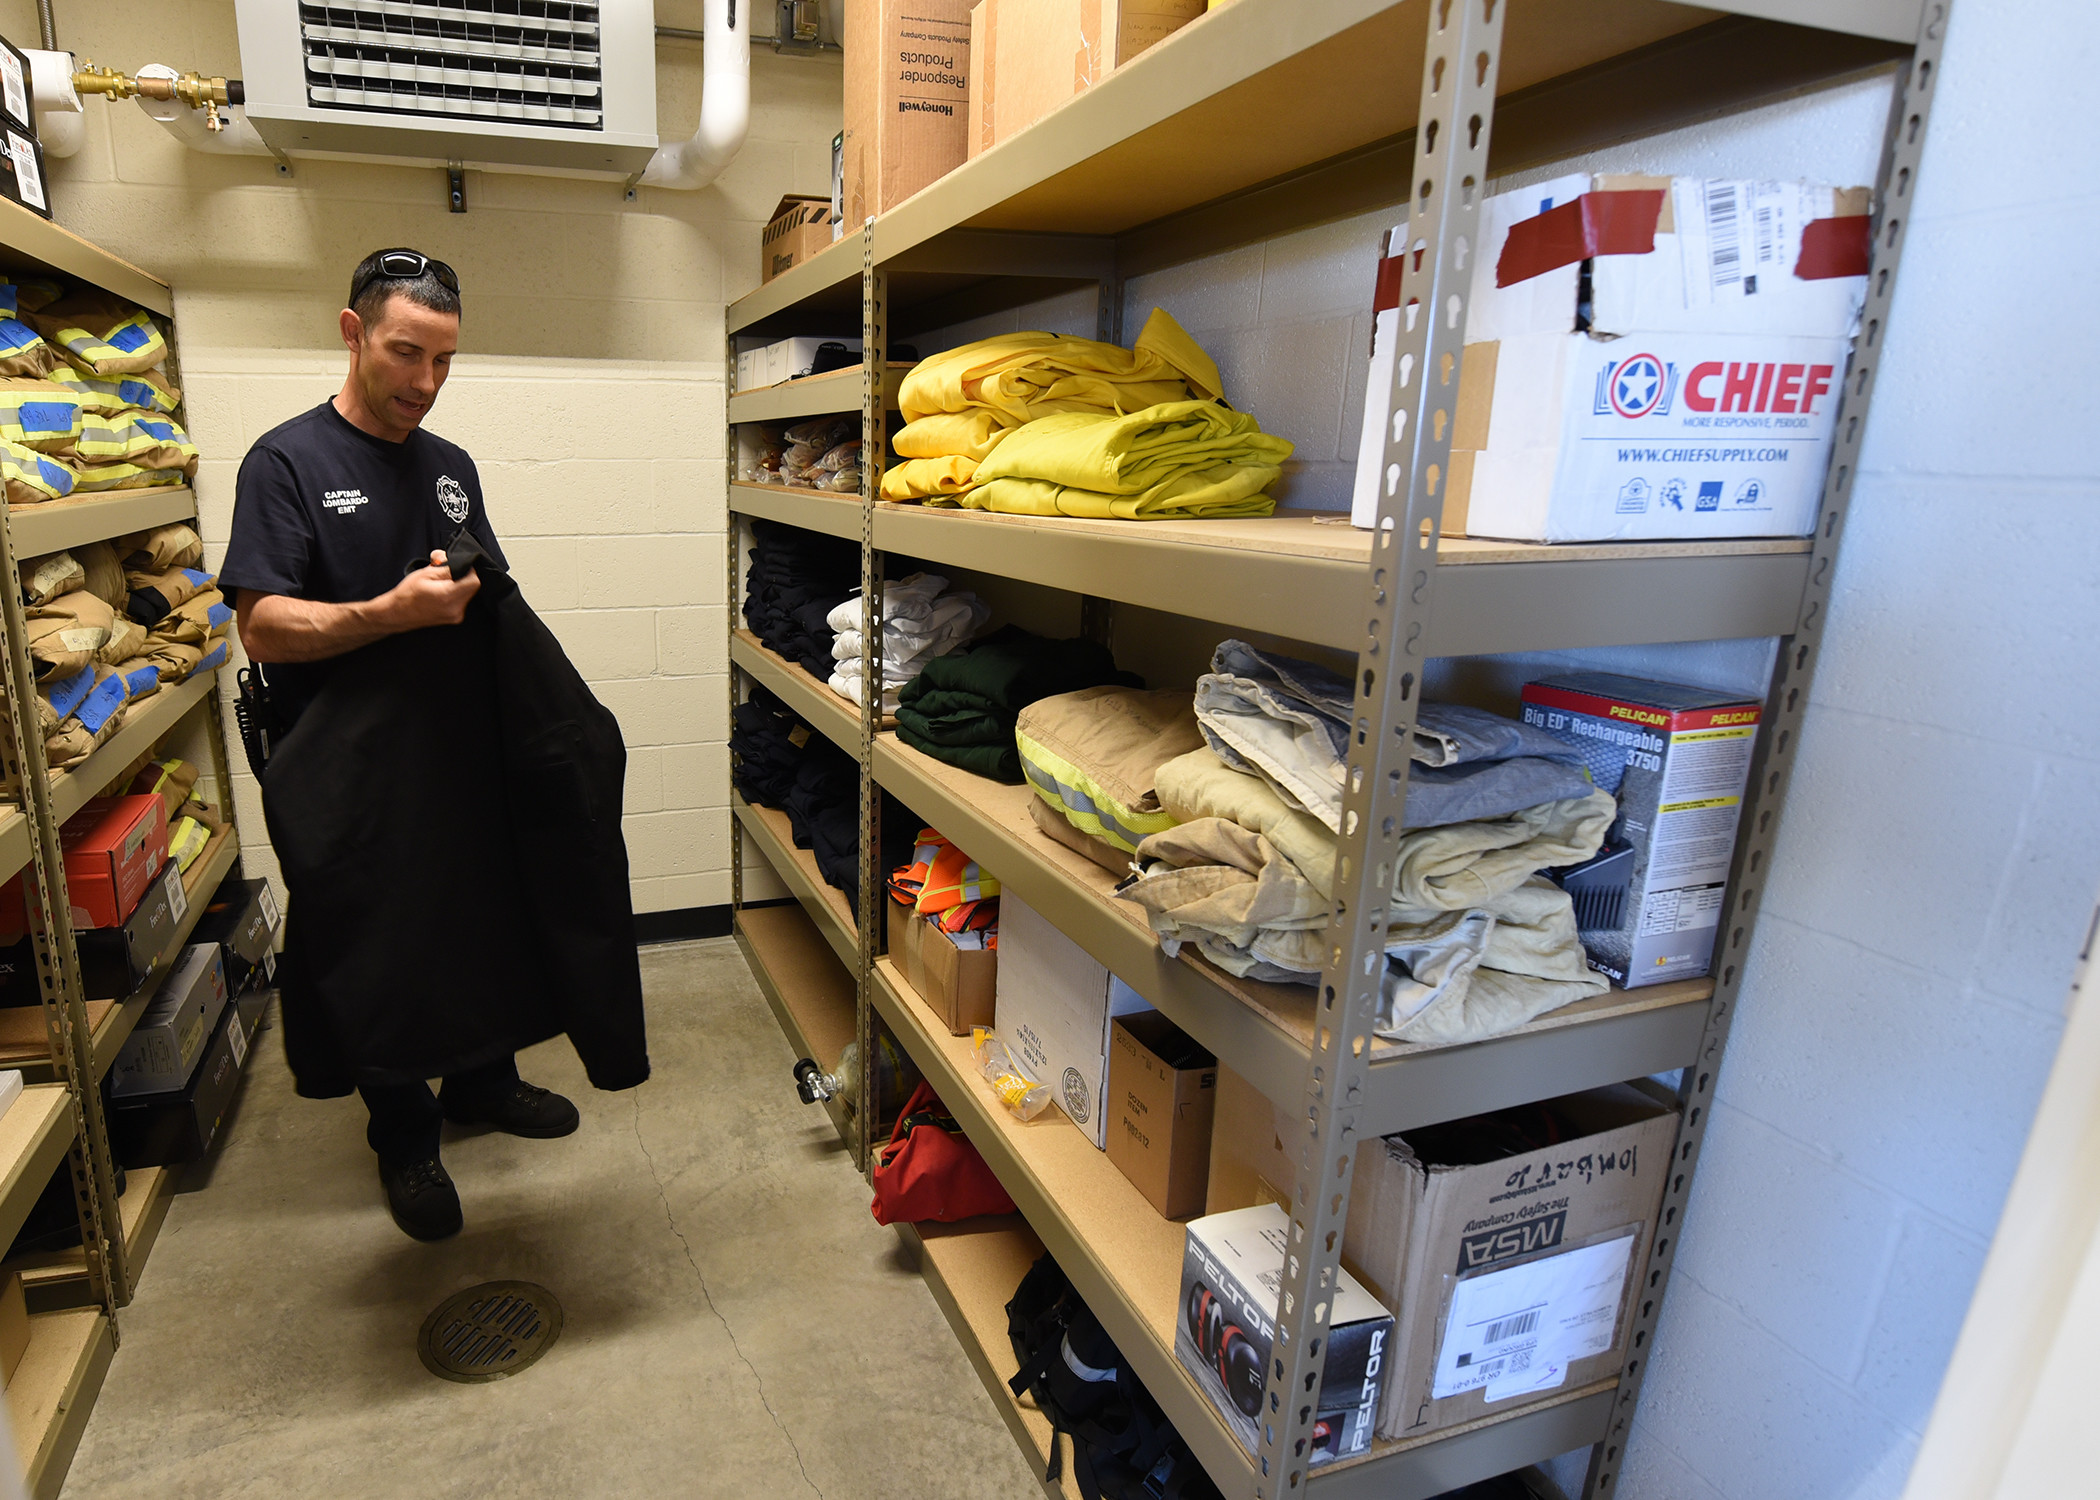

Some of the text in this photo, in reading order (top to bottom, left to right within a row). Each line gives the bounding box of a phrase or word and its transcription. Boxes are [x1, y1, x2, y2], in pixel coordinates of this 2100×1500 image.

[900, 30, 970, 45] Safety Products Company
[900, 52, 953, 69] Products
[899, 71, 965, 88] Responder
[899, 101, 953, 116] Honeywell
[1683, 361, 1834, 413] CHIEF
[1682, 417, 1809, 429] MORE RESPONSIVE, PERIOD.
[1617, 448, 1788, 463] WWW.CHIEFSUPPLY.COM
[322, 496, 369, 507] LOMBARDO
[324, 489, 361, 499] CAPTAIN
[1696, 495, 1718, 509] GSA
[338, 506, 356, 514] EMT
[1609, 705, 1667, 726] PELICAN
[1710, 711, 1756, 726] PELICAN
[1524, 707, 1545, 728] Big
[1571, 717, 1664, 753] Rechargeable
[1625, 749, 1661, 773] 3750
[1127, 1091, 1149, 1114] DOZEN
[1127, 1100, 1141, 1118] ITEM
[1462, 1196, 1570, 1233] The Safety Company
[1465, 1216, 1561, 1266] MSA
[1351, 1328, 1387, 1452] PELTOR
